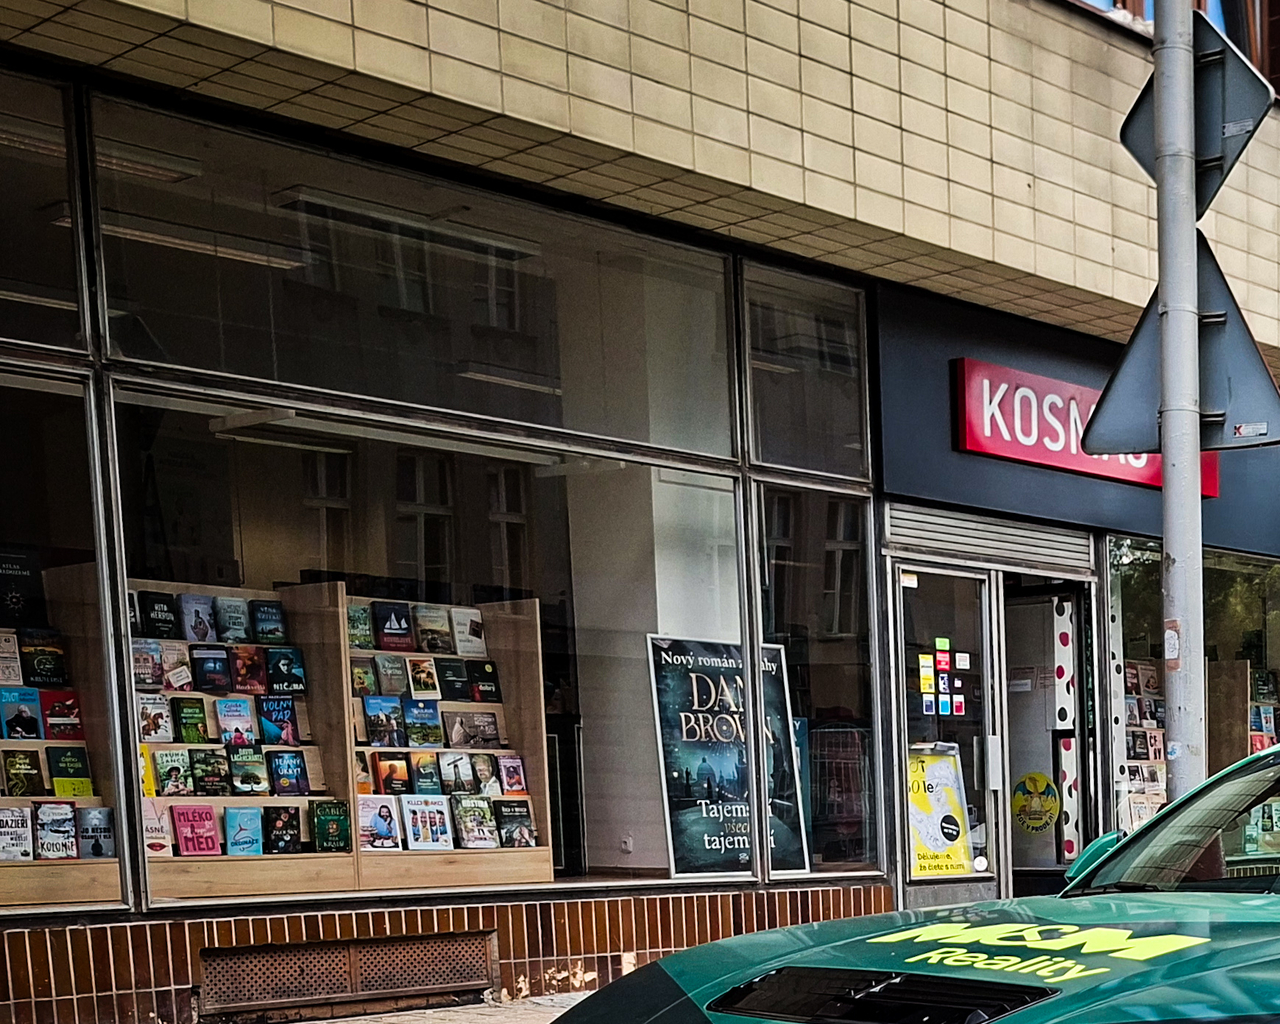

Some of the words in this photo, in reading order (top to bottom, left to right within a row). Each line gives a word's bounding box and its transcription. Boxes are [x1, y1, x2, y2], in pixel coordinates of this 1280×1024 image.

[983, 379, 1148, 468] KOSM
[660, 651, 694, 669] Nový
[698, 654, 736, 668] román
[177, 808, 213, 823] MLÉKO
[183, 836, 216, 851] MED
[865, 922, 1212, 961] M&M
[904, 947, 1112, 983] Reality
